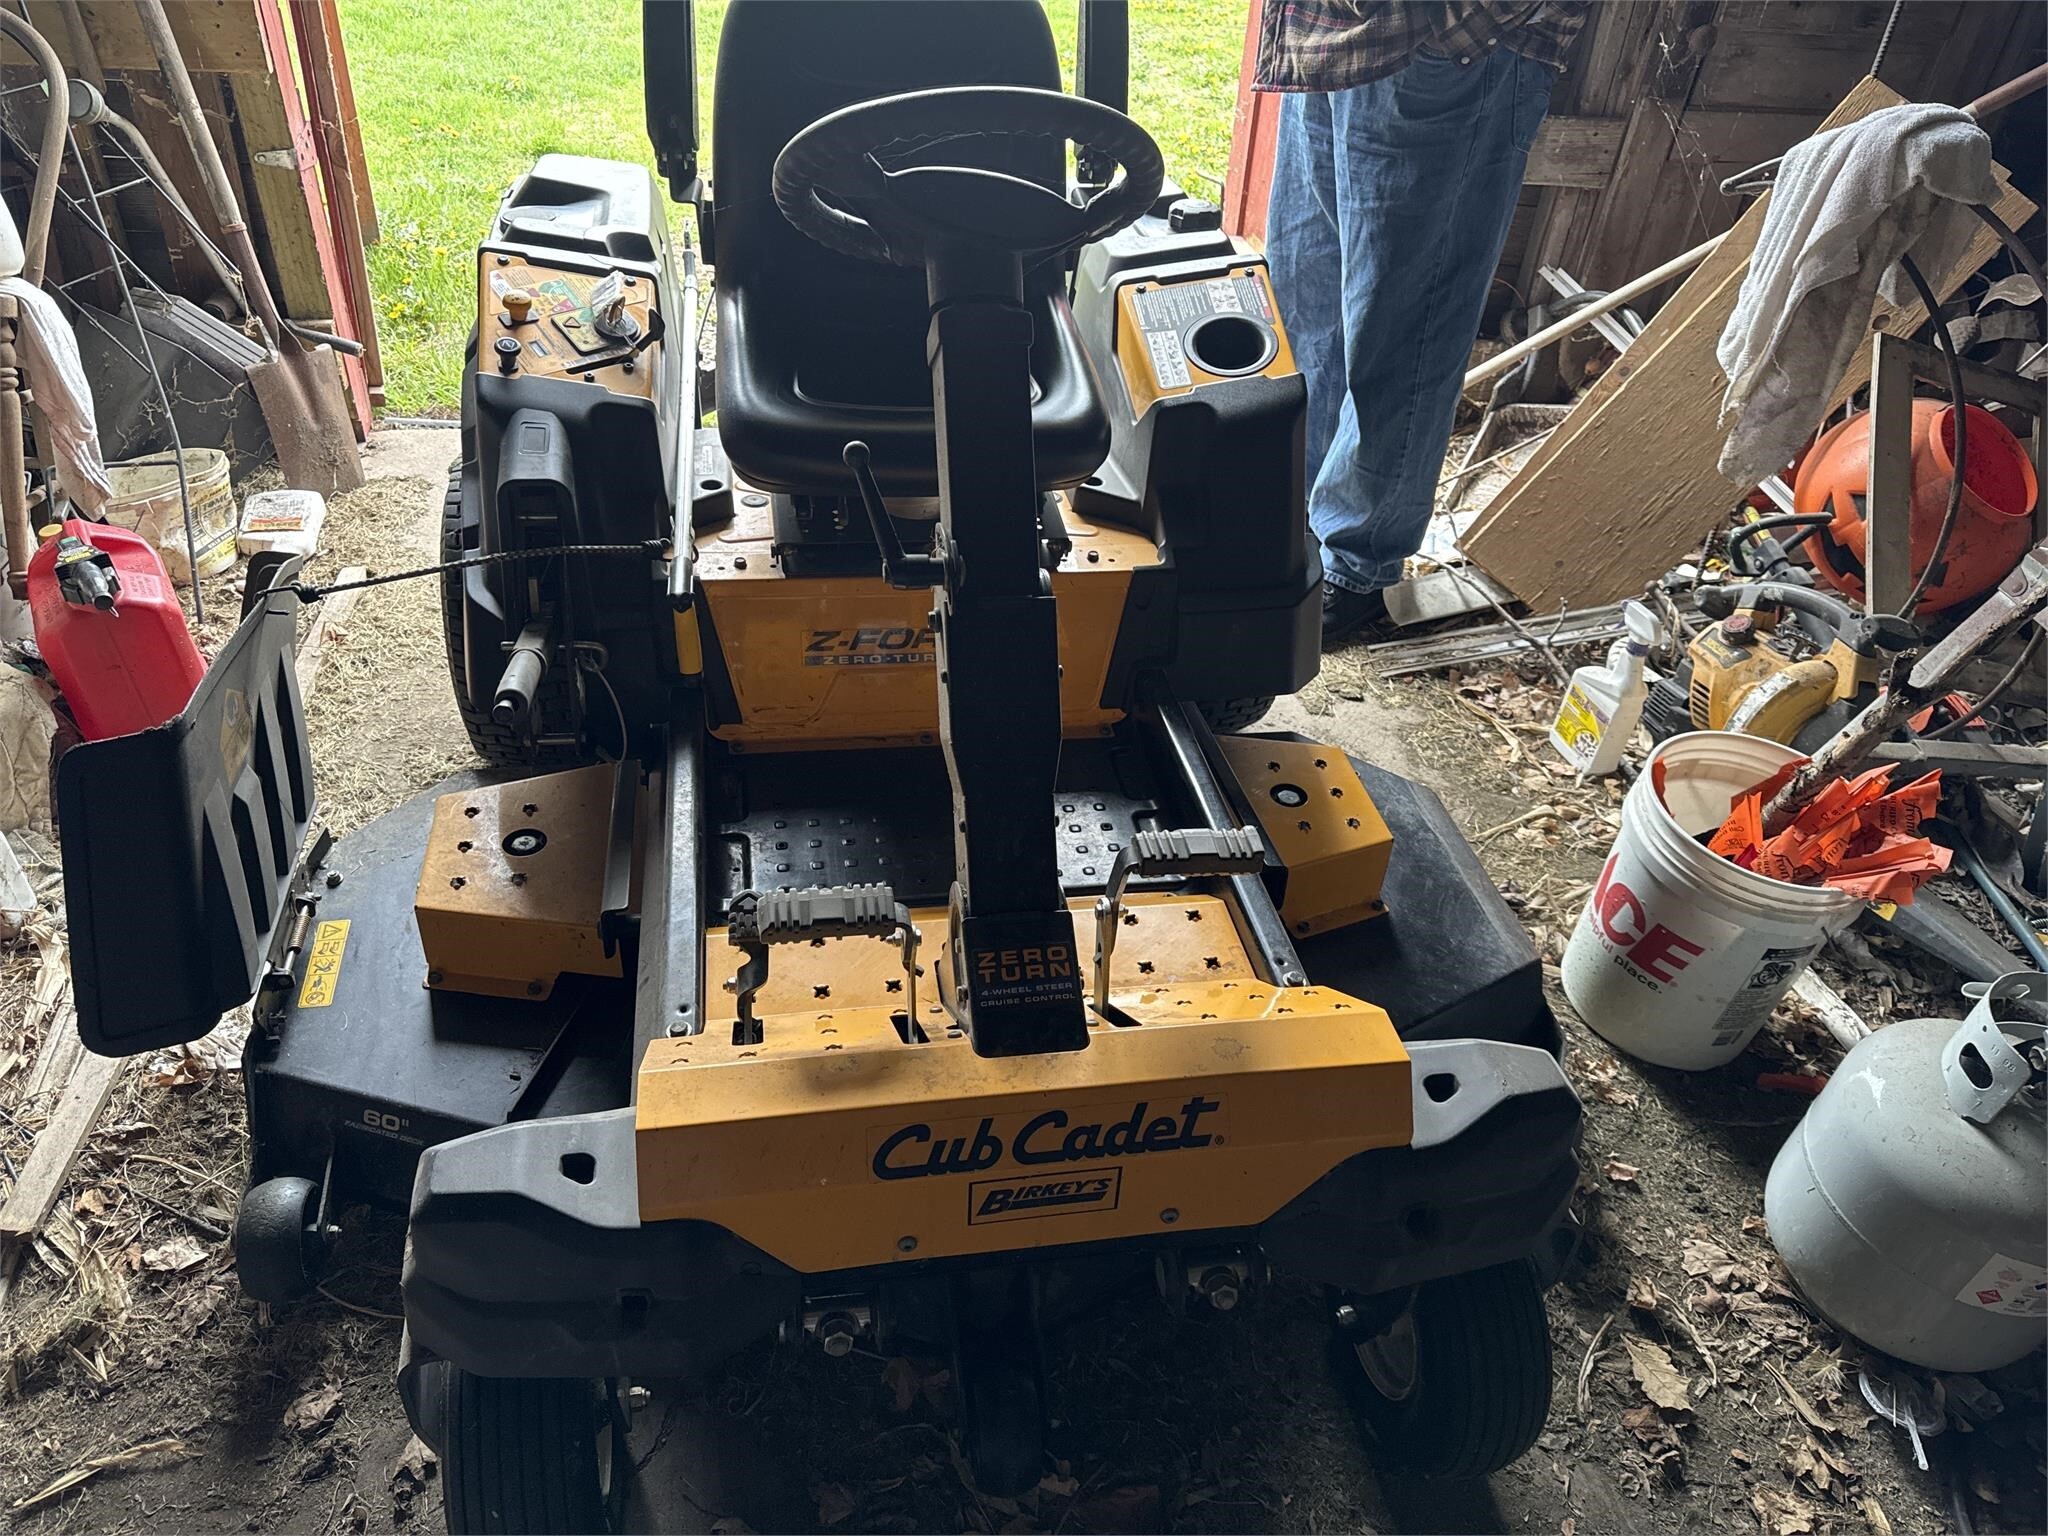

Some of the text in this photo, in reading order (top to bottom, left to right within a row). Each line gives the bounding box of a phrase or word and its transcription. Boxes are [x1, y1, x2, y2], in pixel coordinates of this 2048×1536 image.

[977, 946, 1068, 967] ZERO
[978, 962, 1071, 984] TURN
[1613, 955, 1662, 994] place.
[981, 982, 1073, 996] 4-WHEEL STEER
[980, 994, 1076, 1007] CRUISE CONTROL
[363, 1109, 409, 1131] 60"
[872, 1096, 1221, 1181] Cub Cadet
[976, 1177, 1112, 1216] BIRKEY'S
